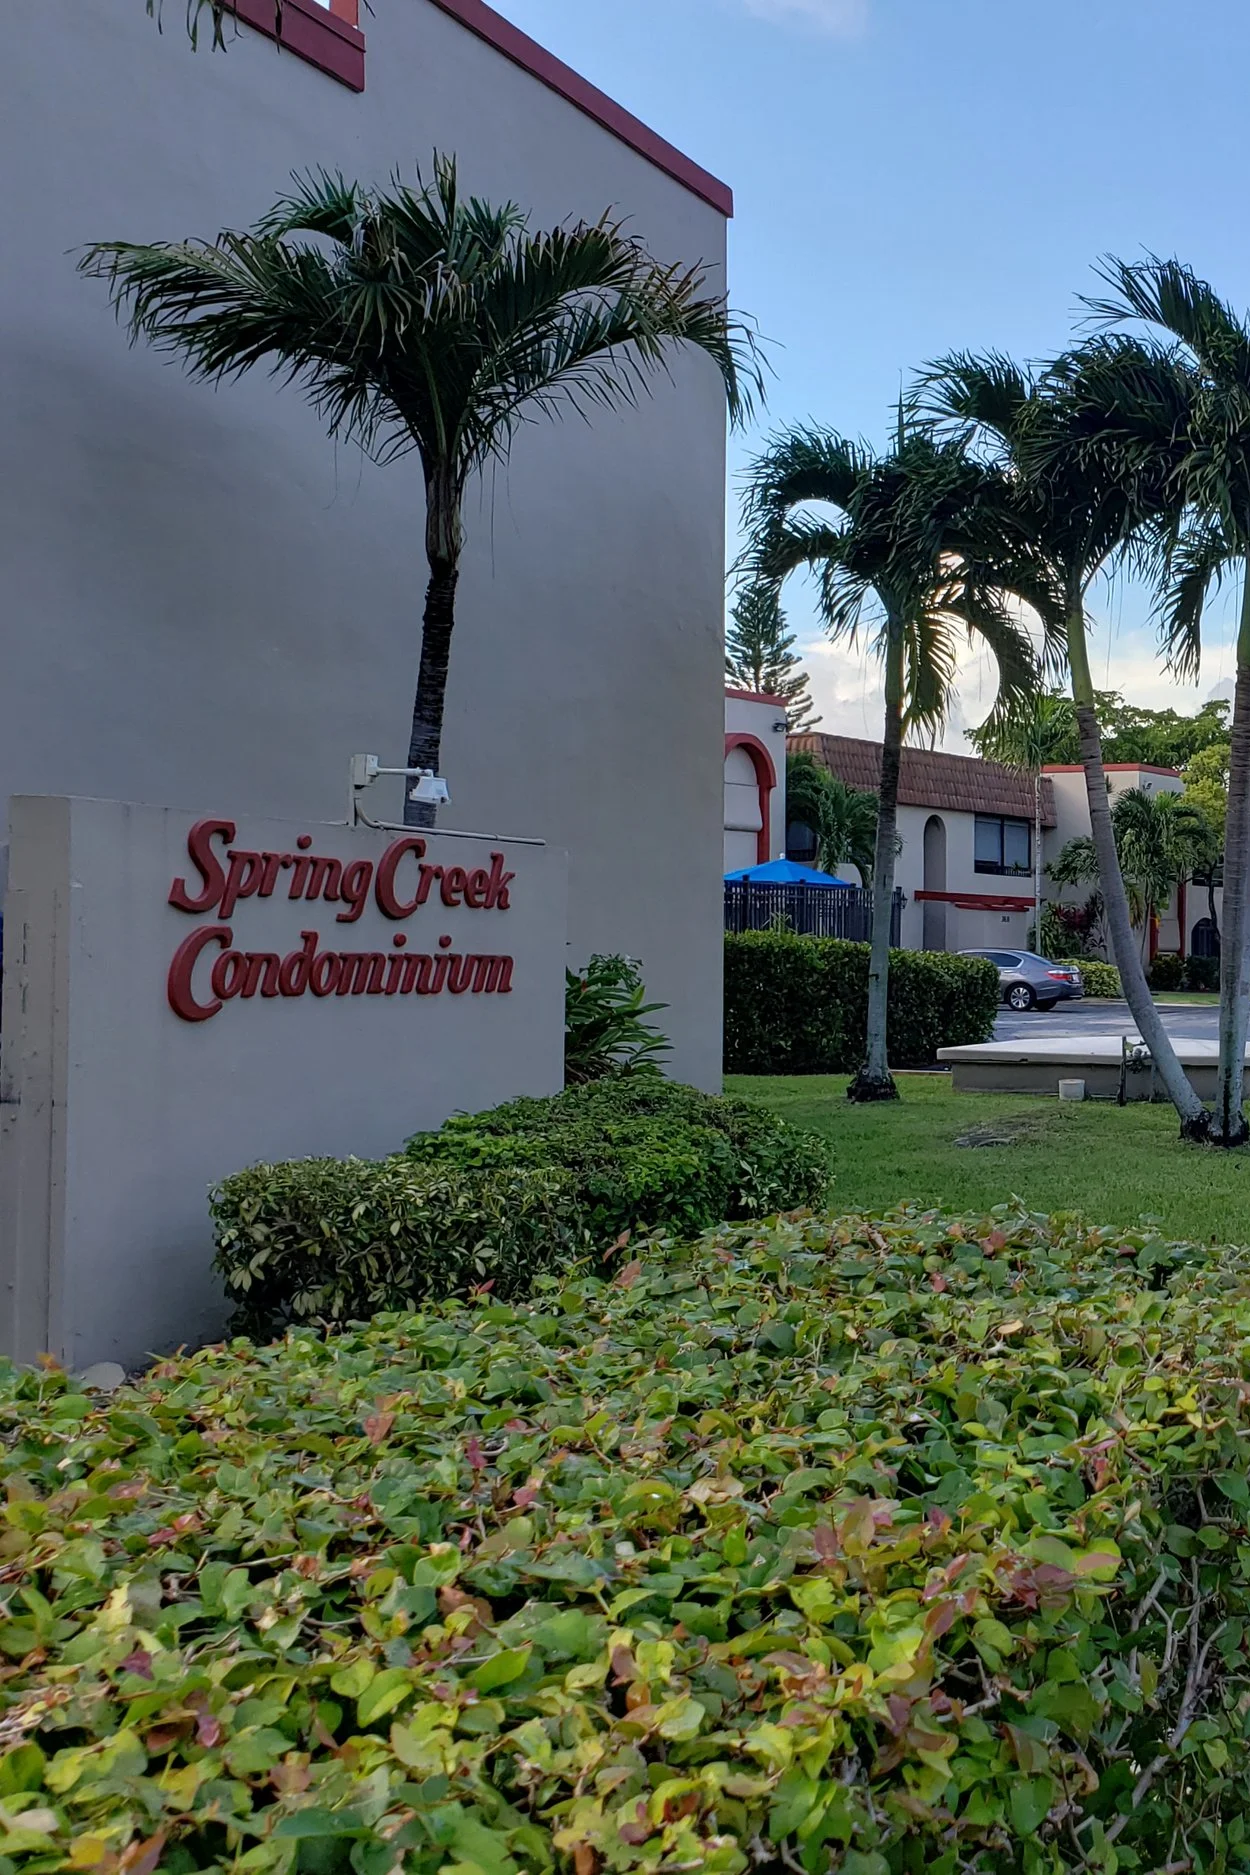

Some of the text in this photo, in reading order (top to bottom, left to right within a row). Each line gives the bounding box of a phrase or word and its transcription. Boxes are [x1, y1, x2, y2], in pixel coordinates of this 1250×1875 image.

[168, 820, 516, 922] Spring Creek
[168, 925, 514, 1022] Condominium
